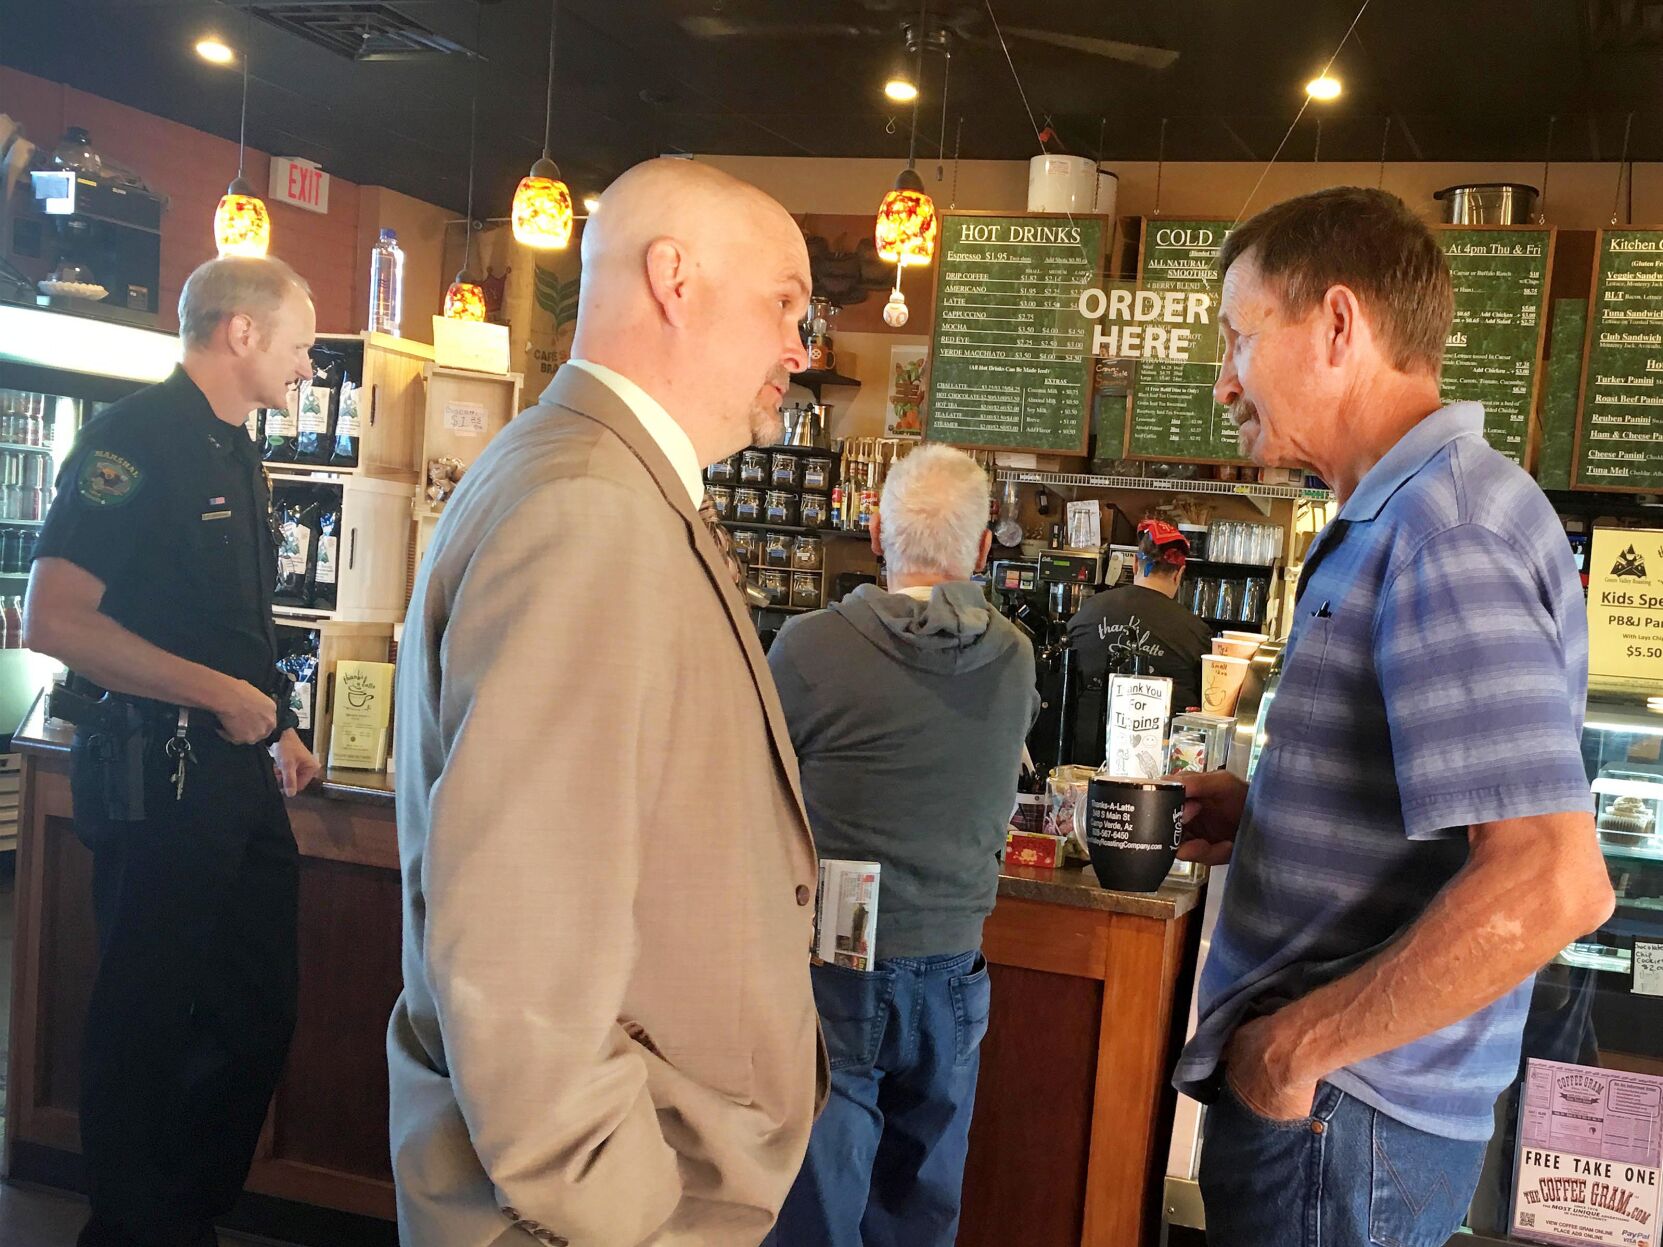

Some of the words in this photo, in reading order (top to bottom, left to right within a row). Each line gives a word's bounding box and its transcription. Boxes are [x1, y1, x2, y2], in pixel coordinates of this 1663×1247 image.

[288, 162, 322, 206] EXIT
[960, 224, 1001, 241] HOT
[1009, 226, 1081, 243] DRINKS
[1156, 229, 1213, 246] COLD
[1449, 244, 1461, 254] At
[1464, 244, 1487, 255] 4pm
[1490, 244, 1510, 254] Thu
[1513, 245, 1523, 254] &
[1526, 245, 1541, 255] Fri
[1610, 239, 1656, 250] Kitchen
[948, 251, 981, 261] Espresso
[985, 252, 1007, 262] $1.95
[1168, 260, 1208, 269] NATURAL
[946, 272, 961, 280] DRIP
[1168, 269, 1218, 278] SMOOTHIES
[1604, 291, 1624, 299] BLT
[1078, 288, 1210, 324] ORDER
[943, 311, 986, 319] CAPPUCCINO
[1603, 309, 1624, 317] Tuna
[1092, 325, 1190, 360] HERE
[1601, 333, 1620, 341] Club
[1622, 333, 1661, 342] Sandwich
[534, 350, 558, 361] CAFE
[963, 350, 1005, 358] MACCHIATO
[1596, 375, 1625, 384] Turkey
[1628, 376, 1654, 385] Panini
[1595, 394, 1618, 403] Roast
[1620, 395, 1639, 403] Beef
[1640, 395, 1663, 405] Panin
[1592, 414, 1623, 422] Reuben
[1625, 415, 1651, 423] Panini
[1590, 430, 1610, 438] Ham
[1612, 431, 1619, 439] &
[1622, 431, 1650, 440] Cheese
[1588, 450, 1616, 458] Cheese
[1618, 451, 1645, 459] Panini
[1587, 466, 1608, 474] Tuna
[1611, 467, 1629, 475] Melt
[1602, 591, 1634, 605] Kids
[1639, 594, 1663, 608] Spe
[1609, 615, 1641, 628] PB&J
[1627, 645, 1662, 658] $5.50
[1117, 683, 1143, 694] Tank
[1146, 685, 1162, 697] You
[1115, 712, 1160, 730] Tiping
[1106, 811, 1121, 820] Main
[1122, 813, 1130, 821] St
[1526, 1150, 1560, 1170] FREE
[1573, 1158, 1611, 1178] TAKE
[1625, 1167, 1655, 1186] ONE
[1523, 1190, 1541, 1204] THE
[1539, 1177, 1586, 1204] COFFEE
[1573, 1208, 1601, 1218] UNIQUE
[1559, 1222, 1577, 1230] COFFEE
[1595, 1227, 1613, 1236] ONLINE
[1622, 1230, 1650, 1240] PayPal
